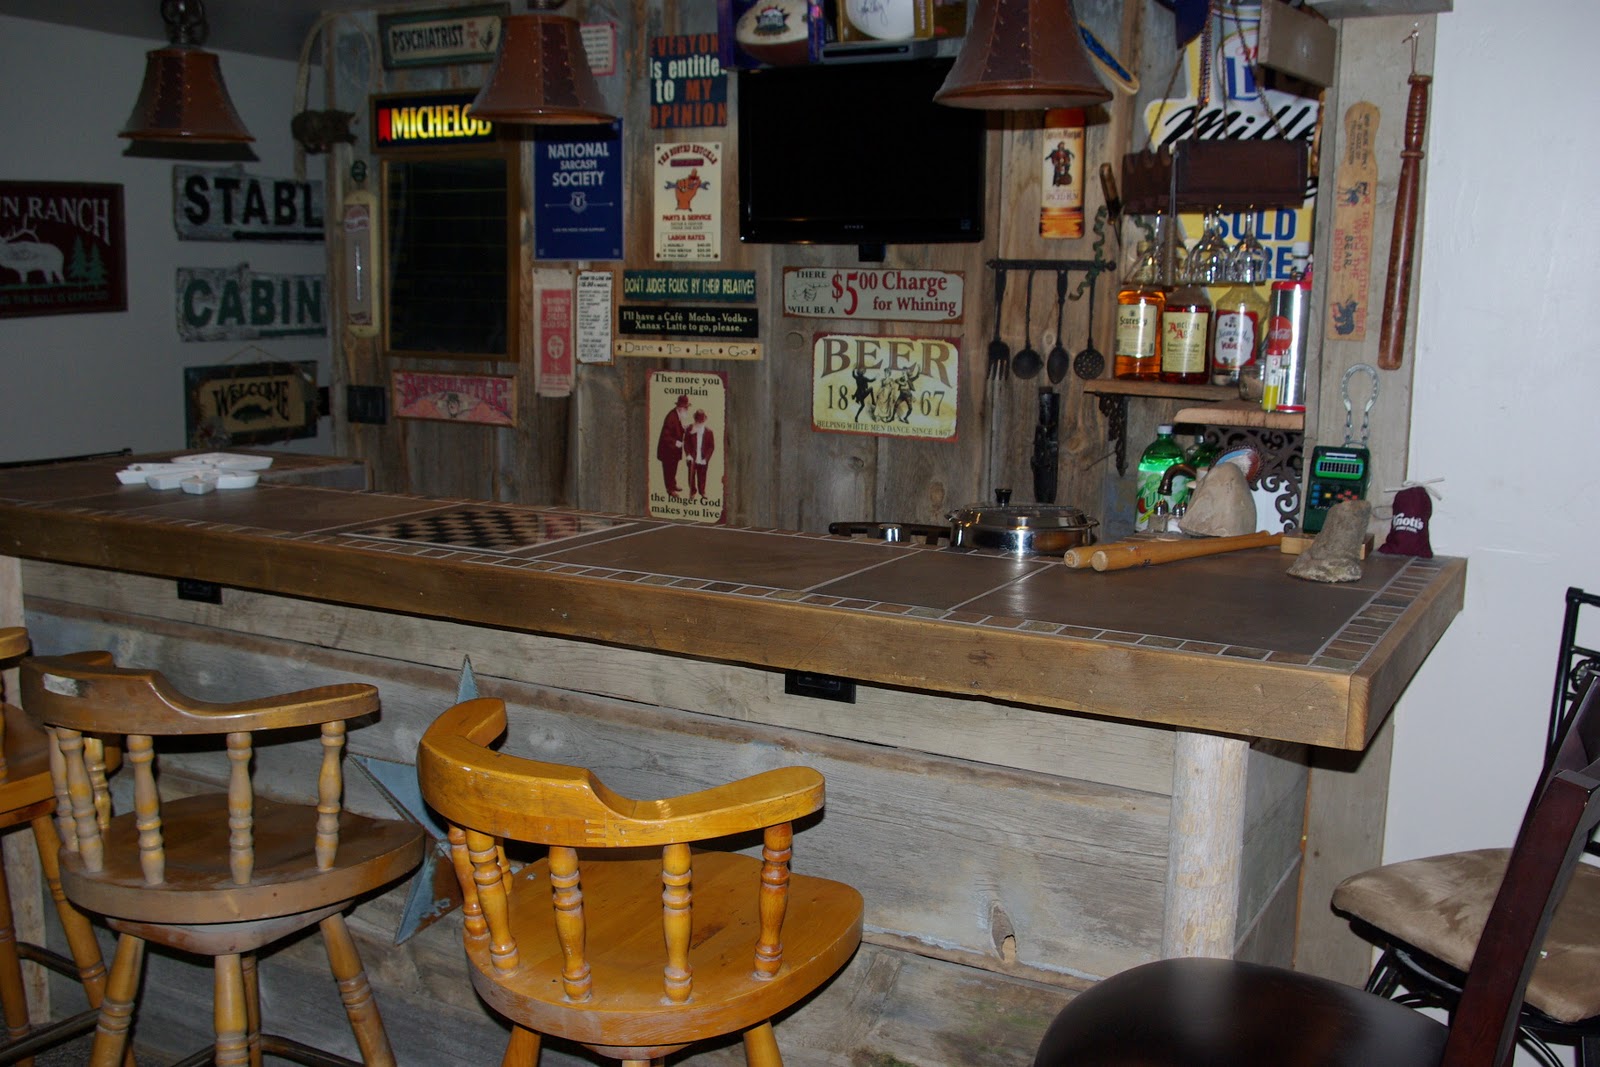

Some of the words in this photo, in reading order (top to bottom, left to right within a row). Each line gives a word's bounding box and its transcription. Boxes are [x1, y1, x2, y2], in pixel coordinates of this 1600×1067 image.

[391, 25, 463, 57] PSYCHIATRIST
[649, 33, 719, 57] EVERYON
[668, 54, 728, 79] entitle
[655, 79, 675, 104] to
[685, 79, 713, 101] MY
[650, 102, 728, 129] OPINION
[1164, 105, 1315, 146] Mille
[548, 142, 610, 159] NATIONAL
[560, 159, 597, 170] SARCASM
[552, 171, 605, 187] SOCIETY
[184, 174, 323, 227] STABL
[0, 195, 20, 218] N
[28, 196, 111, 247] RANCH
[624, 275, 644, 293] DON'T
[646, 278, 666, 294] JUDGE
[668, 278, 688, 294] FOLKS
[691, 278, 701, 294] BY
[722, 278, 754, 295] RELATIVES
[882, 272, 948, 297] Charge
[184, 278, 321, 328] CABIN
[788, 305, 811, 314] WILL
[873, 297, 892, 310] for
[897, 298, 956, 316] Whining
[636, 311, 654, 321] have
[664, 312, 683, 322] Café
[688, 312, 716, 322] Mocha
[722, 312, 748, 323] Vodka
[1120, 316, 1148, 326] Scoresy
[636, 322, 661, 330] Xanax
[666, 322, 686, 331] Latte
[688, 322, 698, 332] to
[712, 322, 742, 332] please.
[624, 342, 654, 352] Dare
[667, 344, 681, 354] To
[695, 344, 716, 356] Let
[728, 346, 748, 357] Go
[821, 338, 952, 388] BEER
[655, 374, 672, 382] The
[675, 376, 699, 384] more
[702, 377, 720, 386] you
[213, 381, 289, 420] WELCOME
[664, 386, 708, 396] complain
[828, 385, 848, 410] 18
[920, 390, 945, 416] 67
[816, 420, 846, 429] HELPING
[847, 422, 868, 430] WHITE
[887, 426, 910, 434] DANCE
[912, 428, 932, 436] SINCE
[651, 493, 666, 502] the
[668, 494, 698, 506] longer
[700, 496, 720, 507] God
[652, 505, 680, 514] makes
[683, 508, 700, 518] you
[702, 508, 720, 518] live
